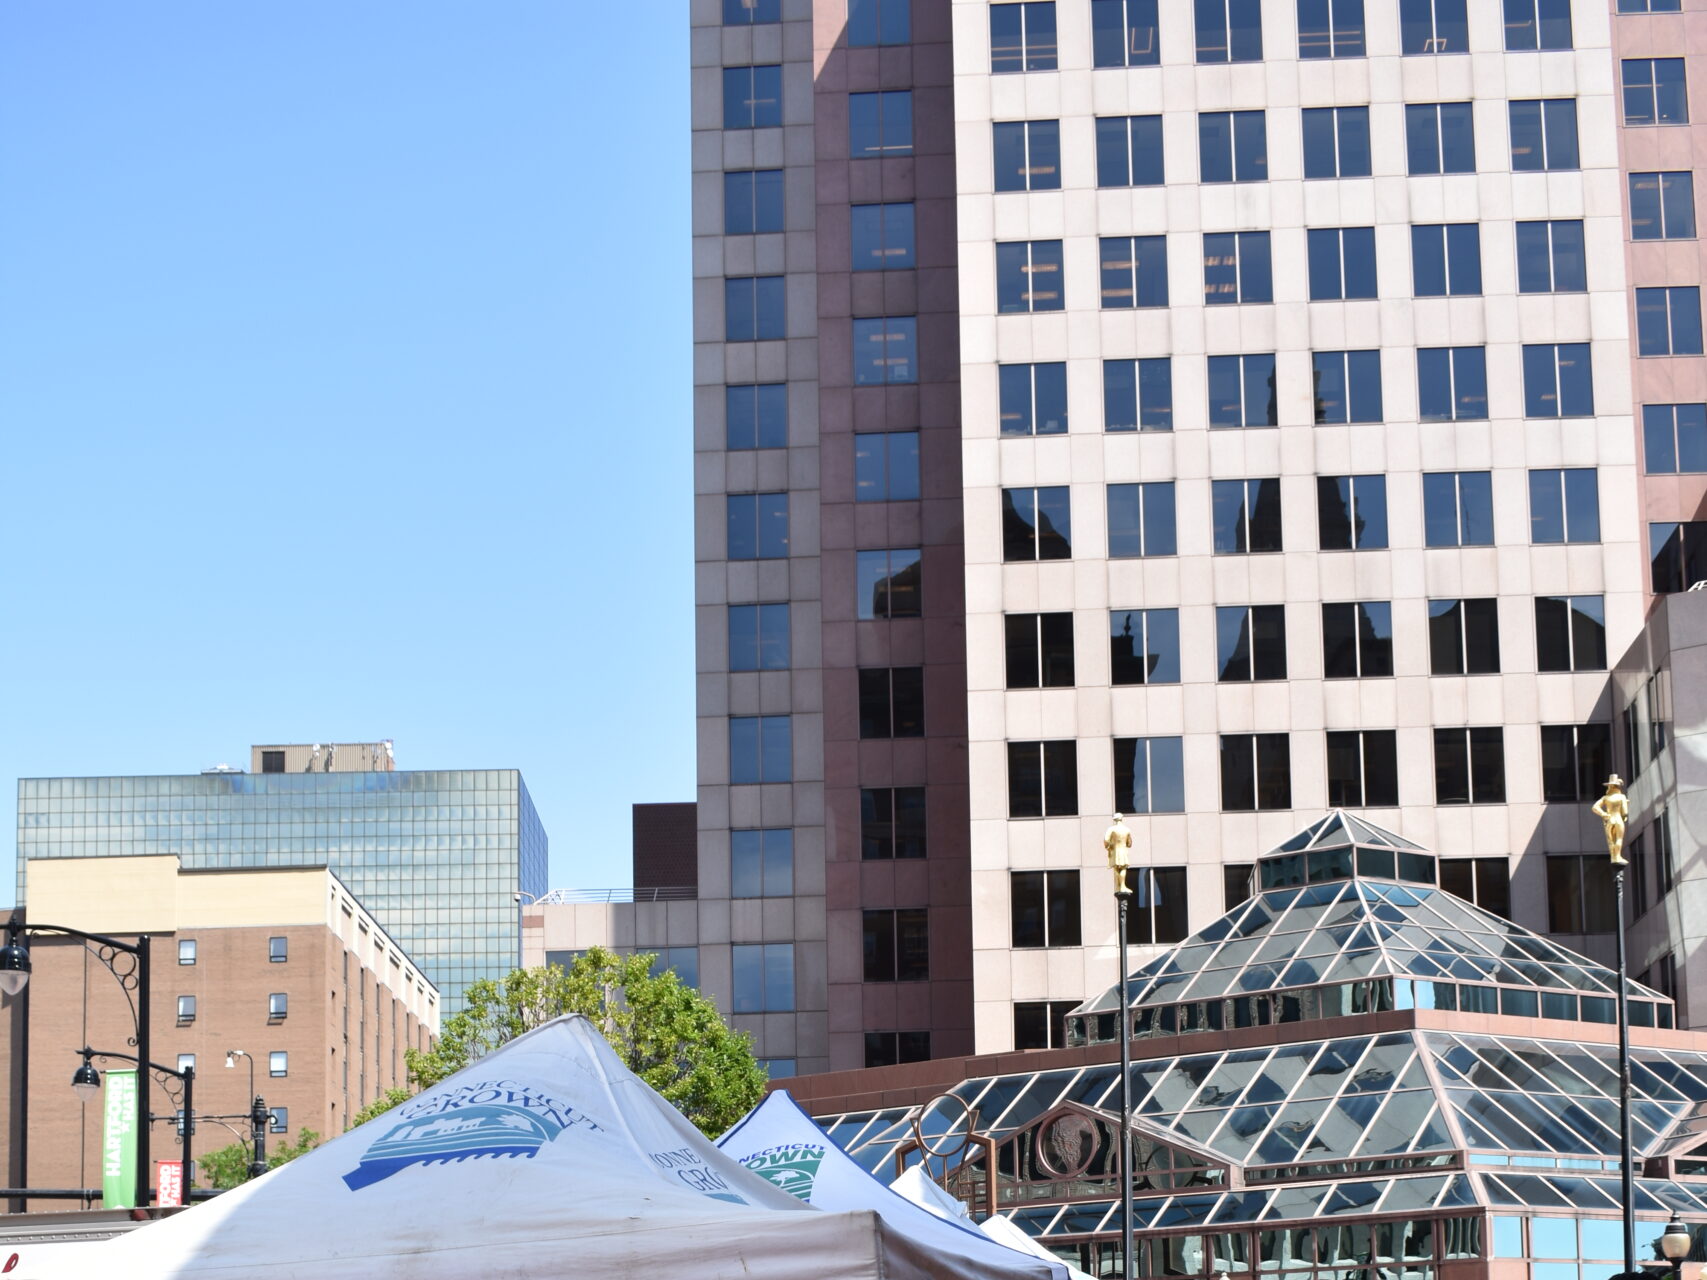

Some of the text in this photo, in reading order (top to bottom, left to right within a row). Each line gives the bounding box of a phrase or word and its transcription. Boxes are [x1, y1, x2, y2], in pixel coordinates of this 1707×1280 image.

[106, 1076, 123, 1176] HARTFORD
[400, 1080, 604, 1133] CONNECTICUT
[406, 1090, 575, 1130] GROWN
